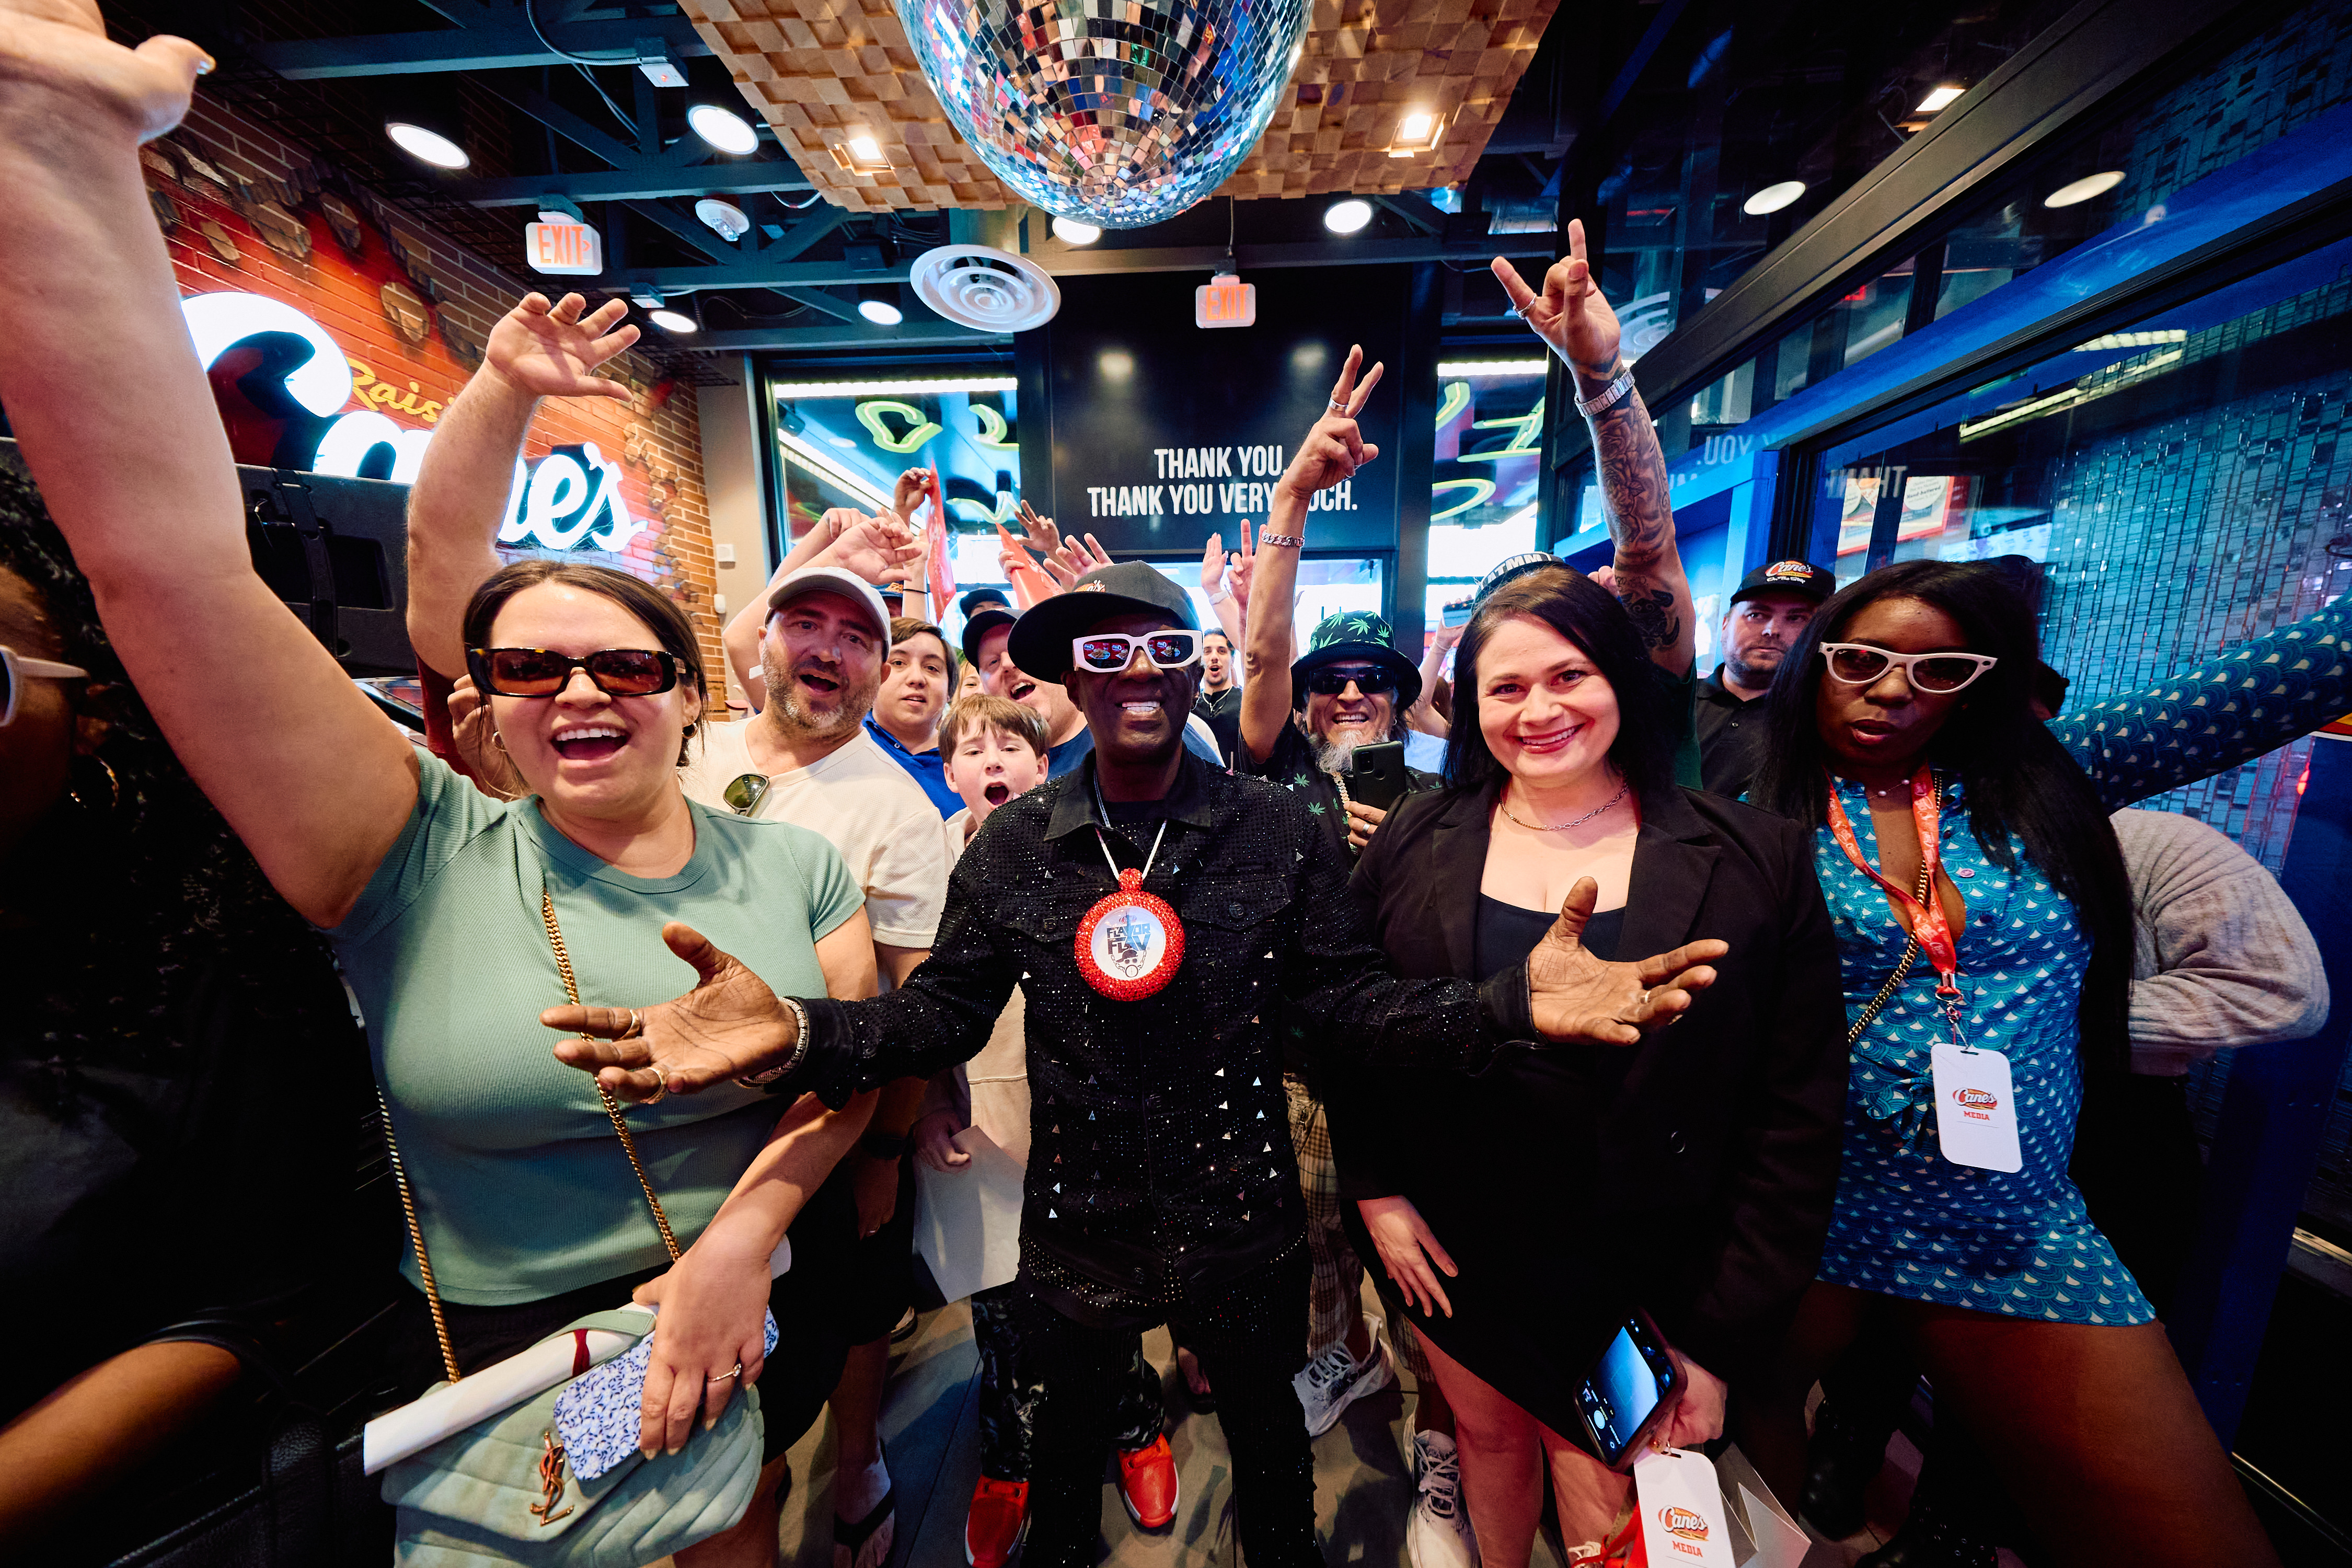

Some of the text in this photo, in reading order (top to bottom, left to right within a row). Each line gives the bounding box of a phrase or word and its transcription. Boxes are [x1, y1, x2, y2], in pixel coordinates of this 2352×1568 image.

[537, 224, 584, 266] EXIT
[1206, 284, 1249, 320] EXIT
[1154, 445, 1232, 479] THANK
[1086, 479, 1358, 517] THANK YOU VERY UCH.
[1766, 561, 1814, 577] Cane's
[1106, 923, 1151, 939] FLAVOR
[1954, 1087, 1997, 1106] Cane's
[1963, 1110, 1990, 1121] MEDIA
[1660, 1505, 1708, 1532] Cane's
[1671, 1540, 1703, 1558] MEDIA
